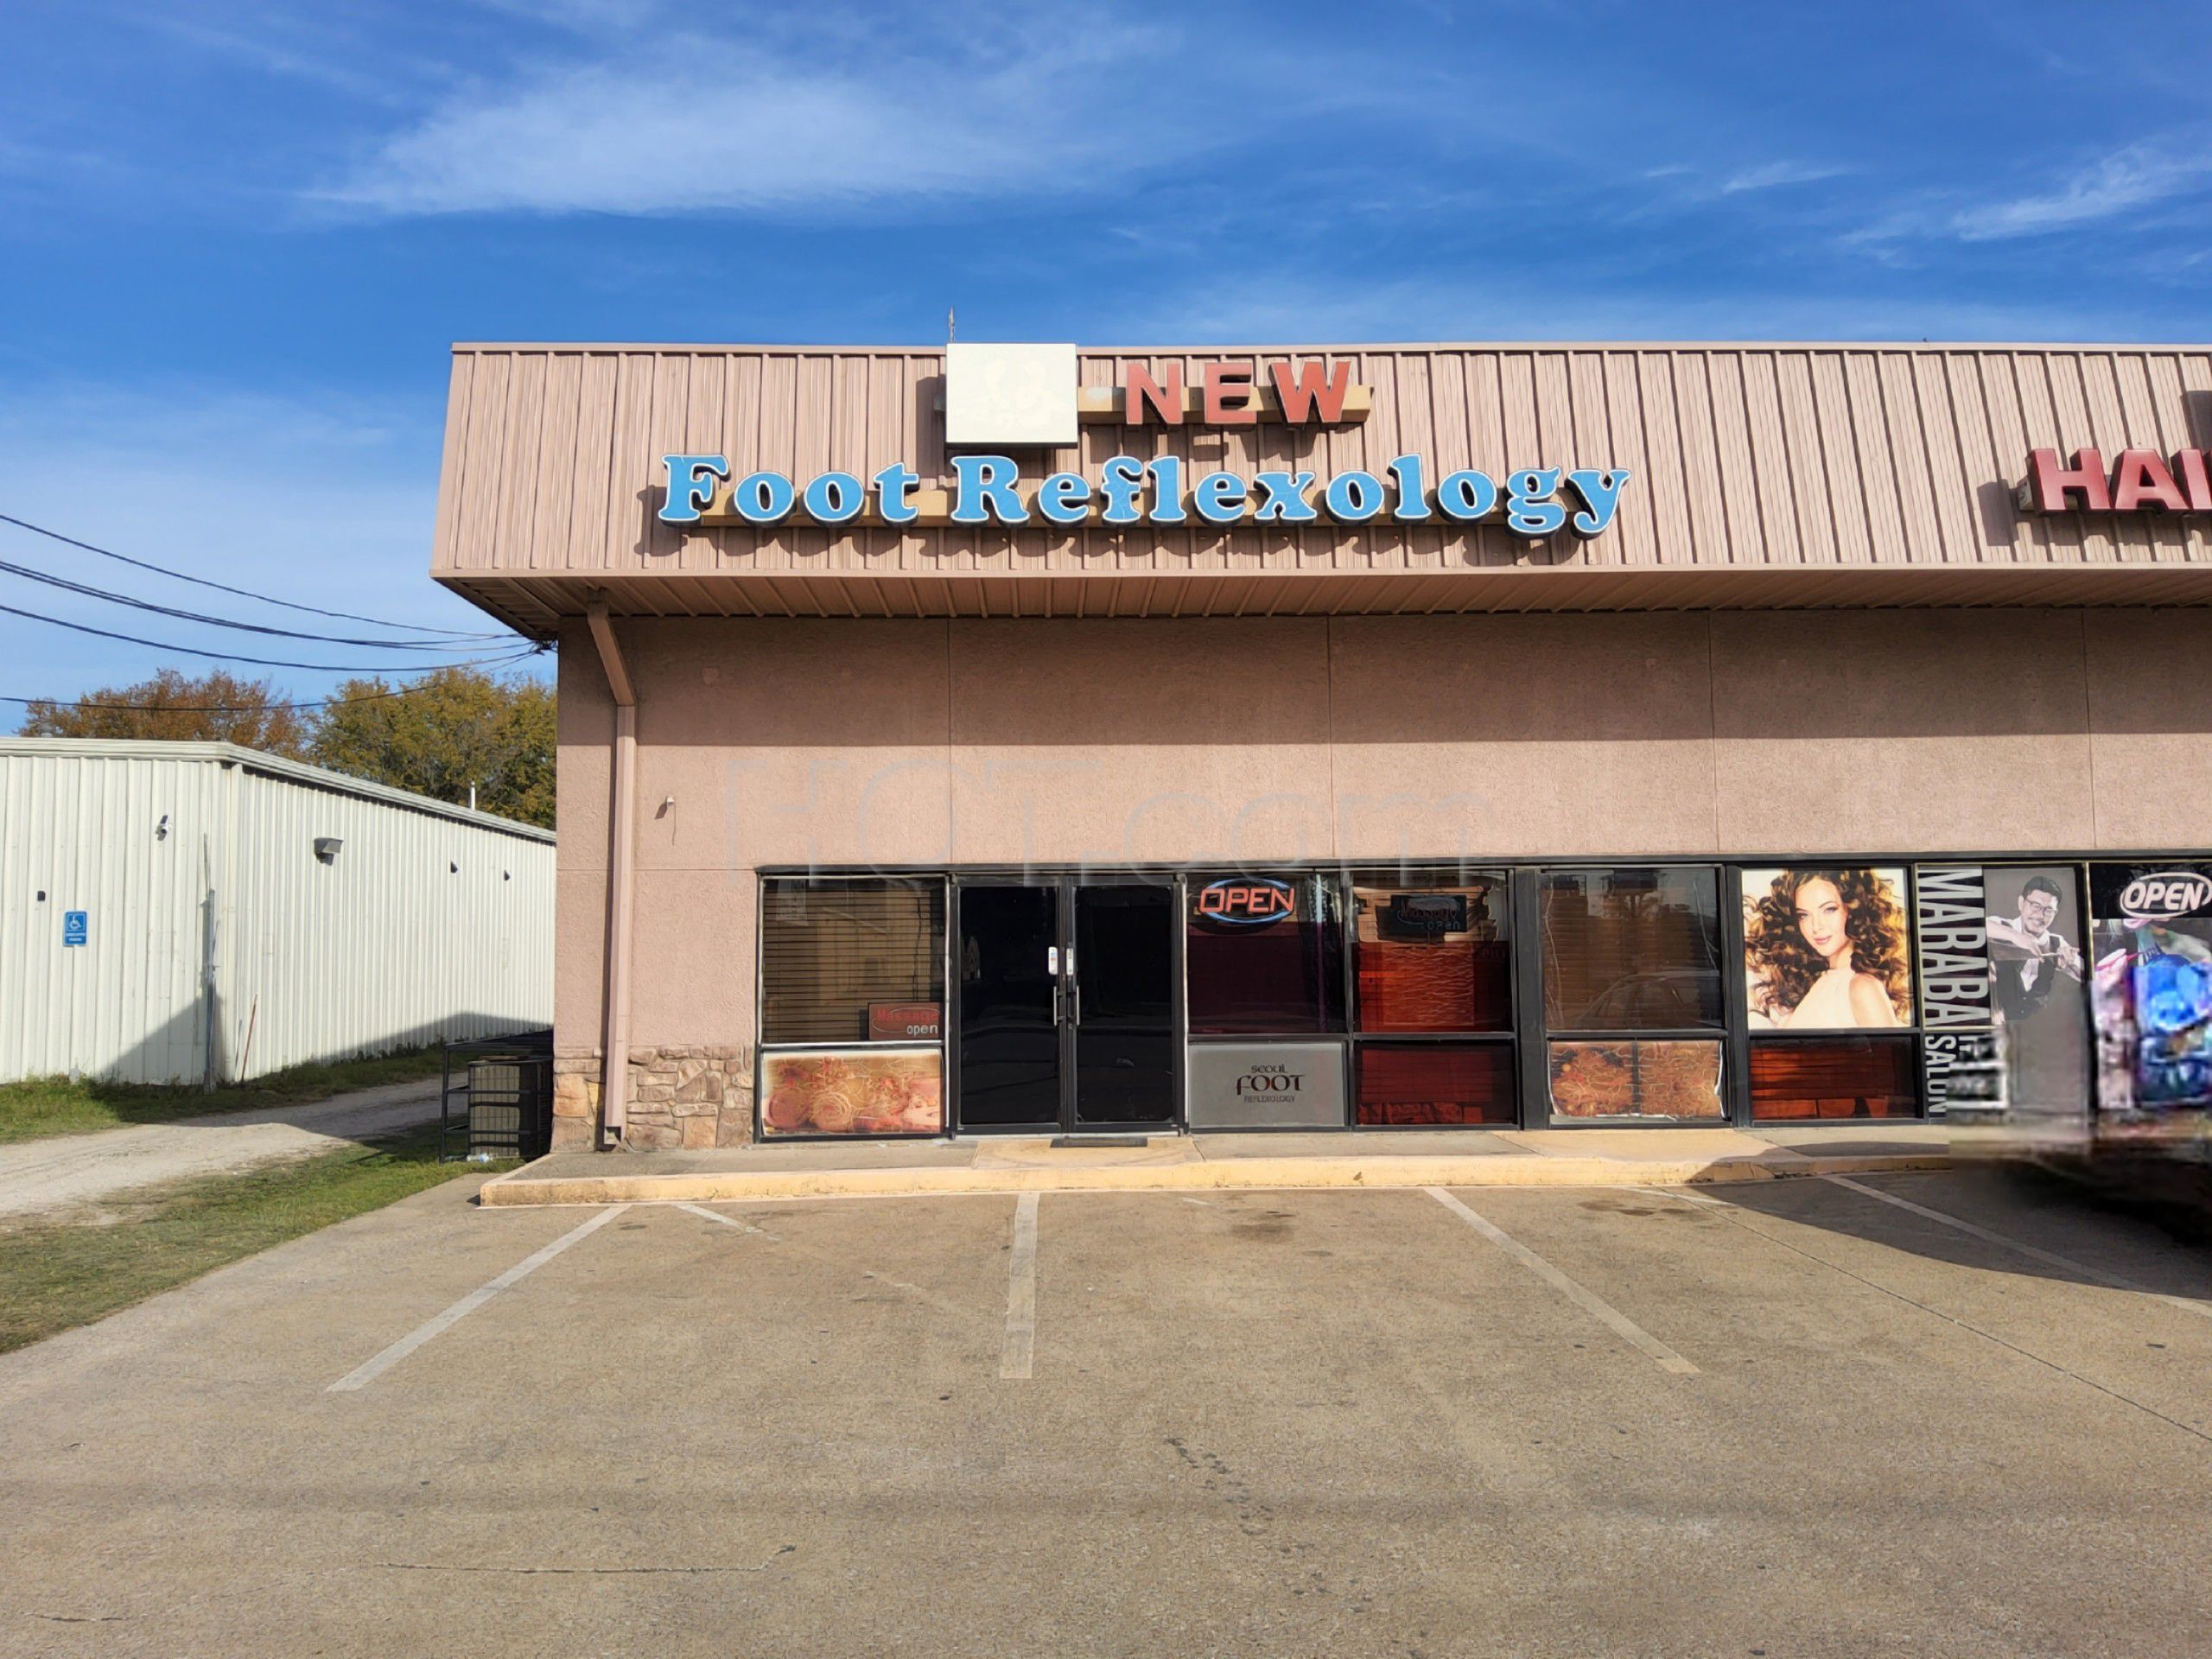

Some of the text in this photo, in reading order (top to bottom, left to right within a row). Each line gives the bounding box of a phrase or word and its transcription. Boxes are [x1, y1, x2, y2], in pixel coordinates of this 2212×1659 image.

[1125, 360, 1351, 426] NEW
[658, 452, 1632, 537] Foot Reflexology
[1198, 887, 1295, 912] OPEN
[2123, 881, 2204, 911] OPEN
[1917, 868, 1991, 1027] MARABA
[906, 1025, 938, 1037] open
